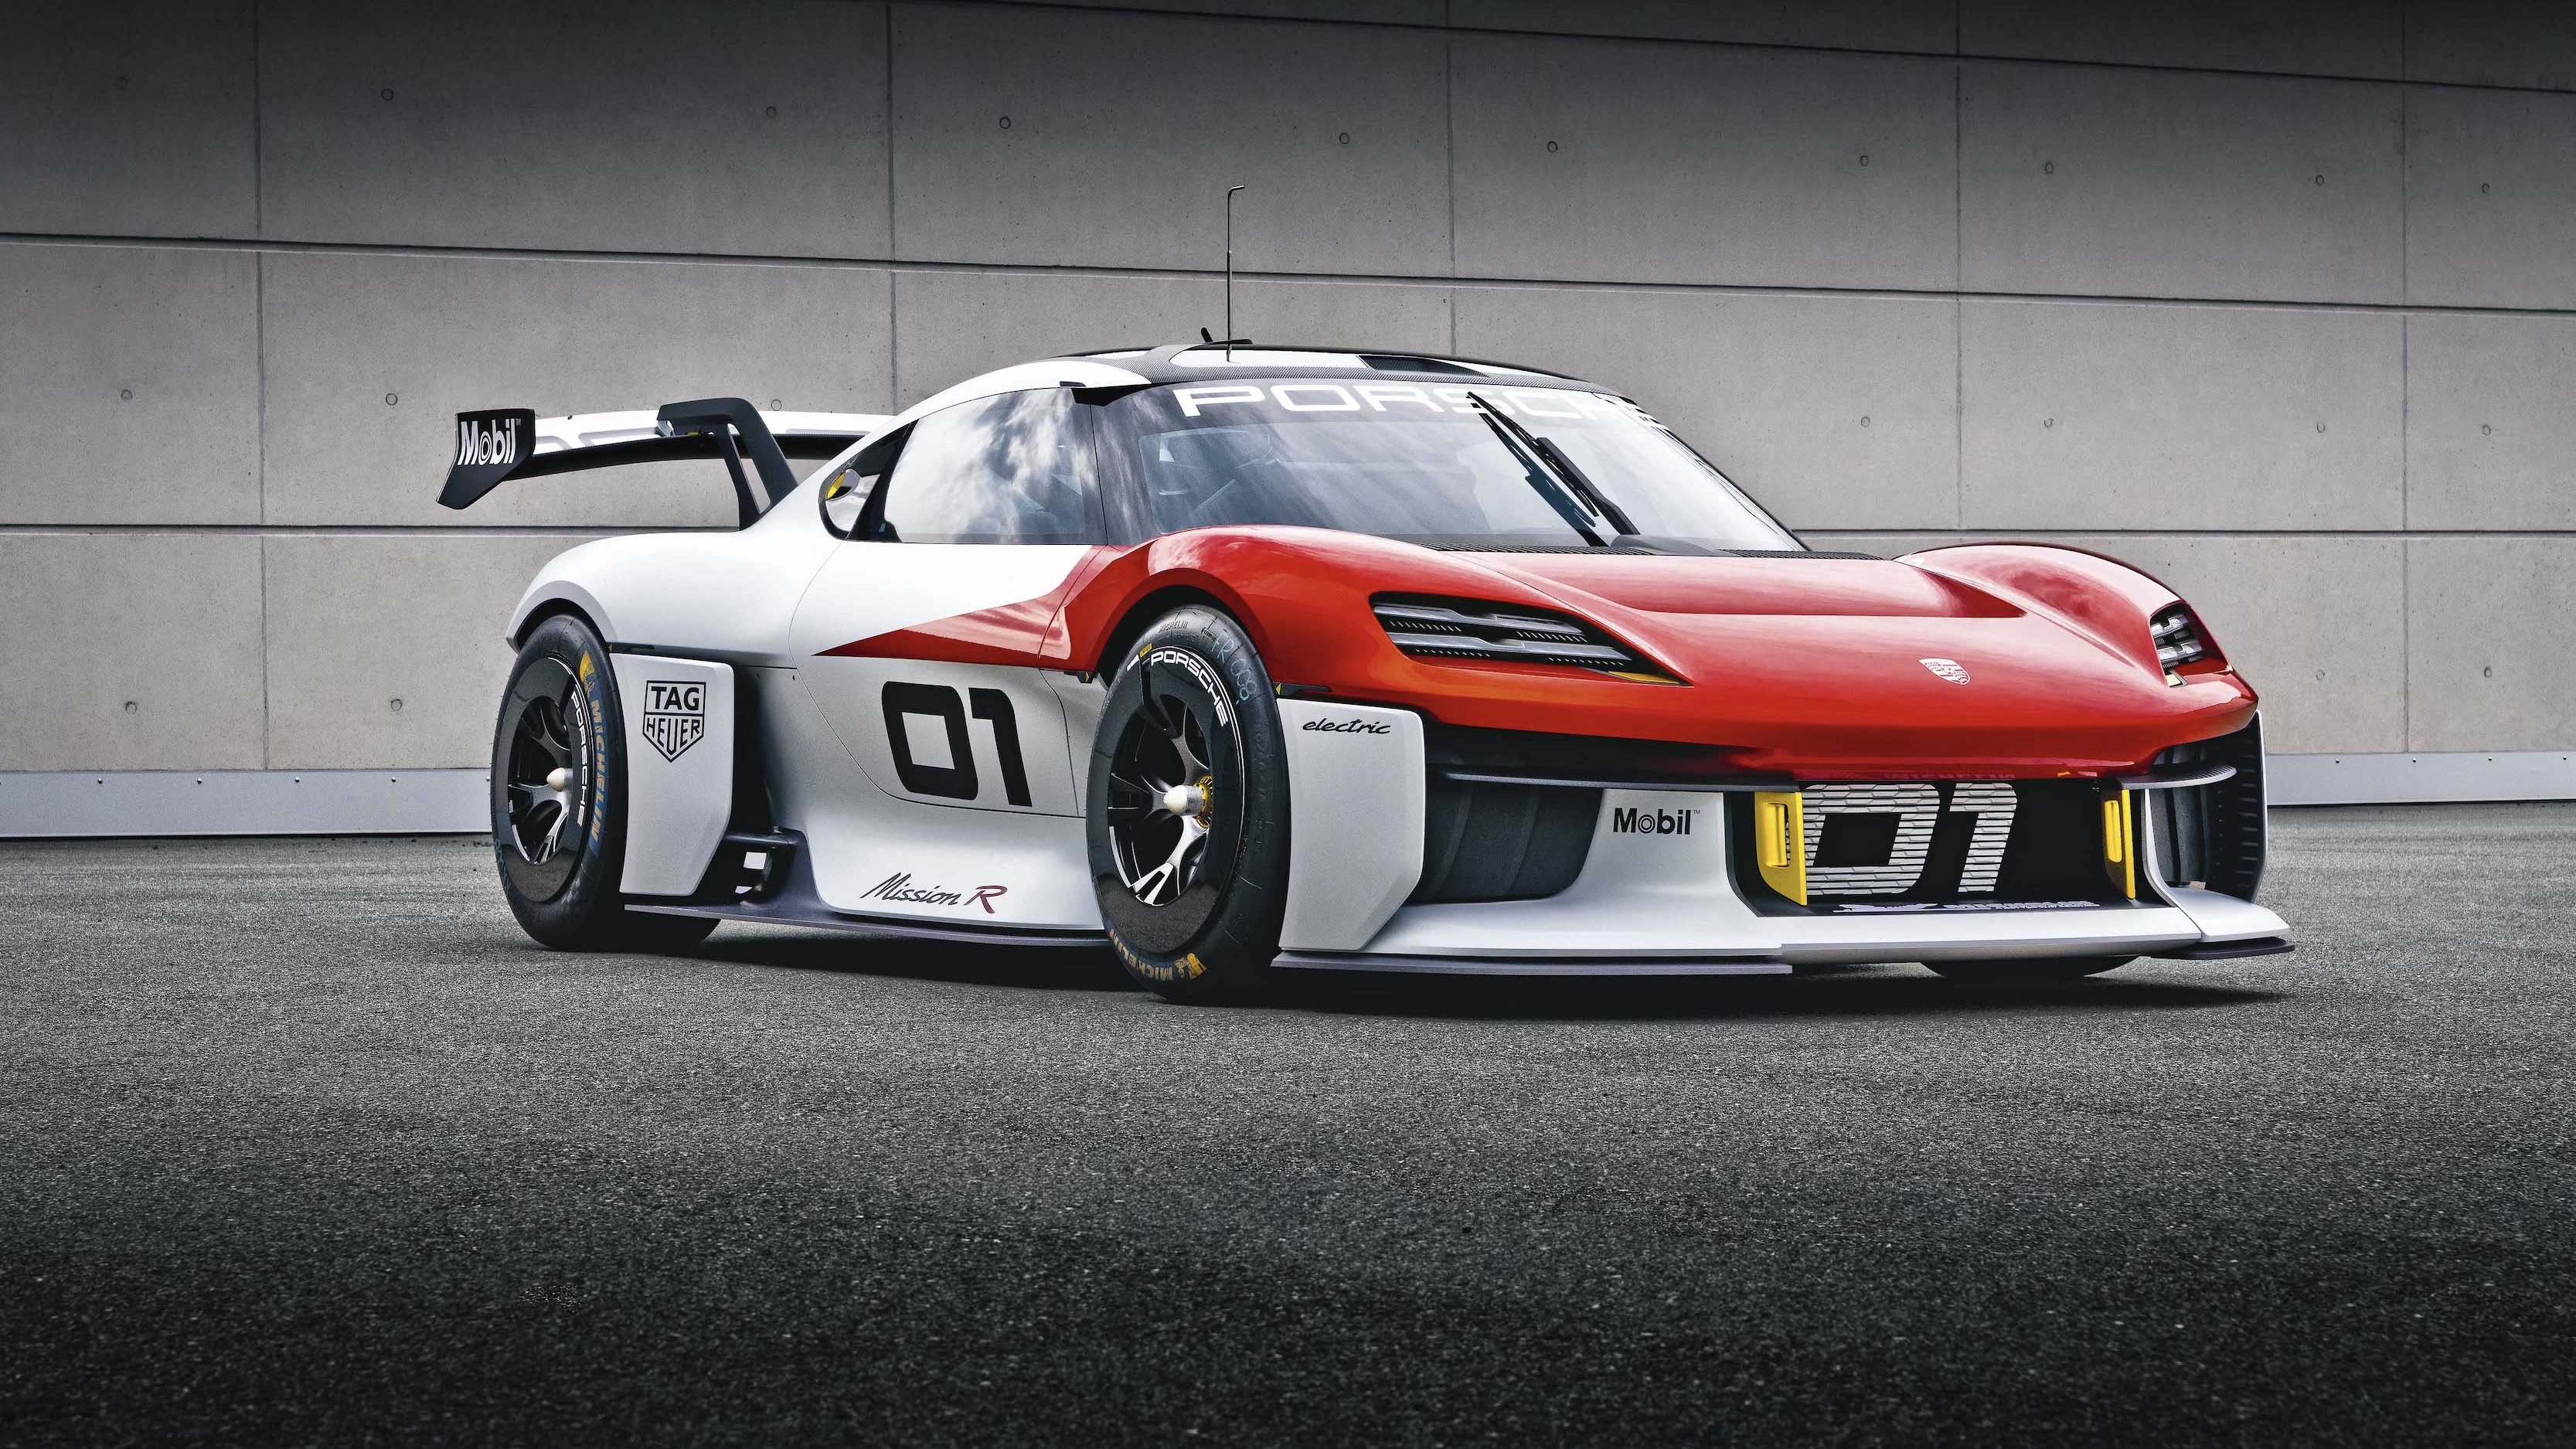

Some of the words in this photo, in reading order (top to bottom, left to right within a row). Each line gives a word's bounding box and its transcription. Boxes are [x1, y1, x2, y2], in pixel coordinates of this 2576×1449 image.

[457, 418, 516, 465] Mobil
[651, 685, 699, 711] TAG
[1150, 650, 1229, 727] PORSCHE
[646, 717, 700, 756] HEUER
[881, 680, 1033, 808] 01
[1302, 717, 1391, 735] electric
[570, 690, 588, 827] PORSCHE
[590, 699, 606, 842] MICHELIN
[1613, 807, 1691, 835] Mobil
[1802, 782, 2018, 896] 01
[859, 872, 962, 906] Mission
[964, 885, 1008, 914] R
